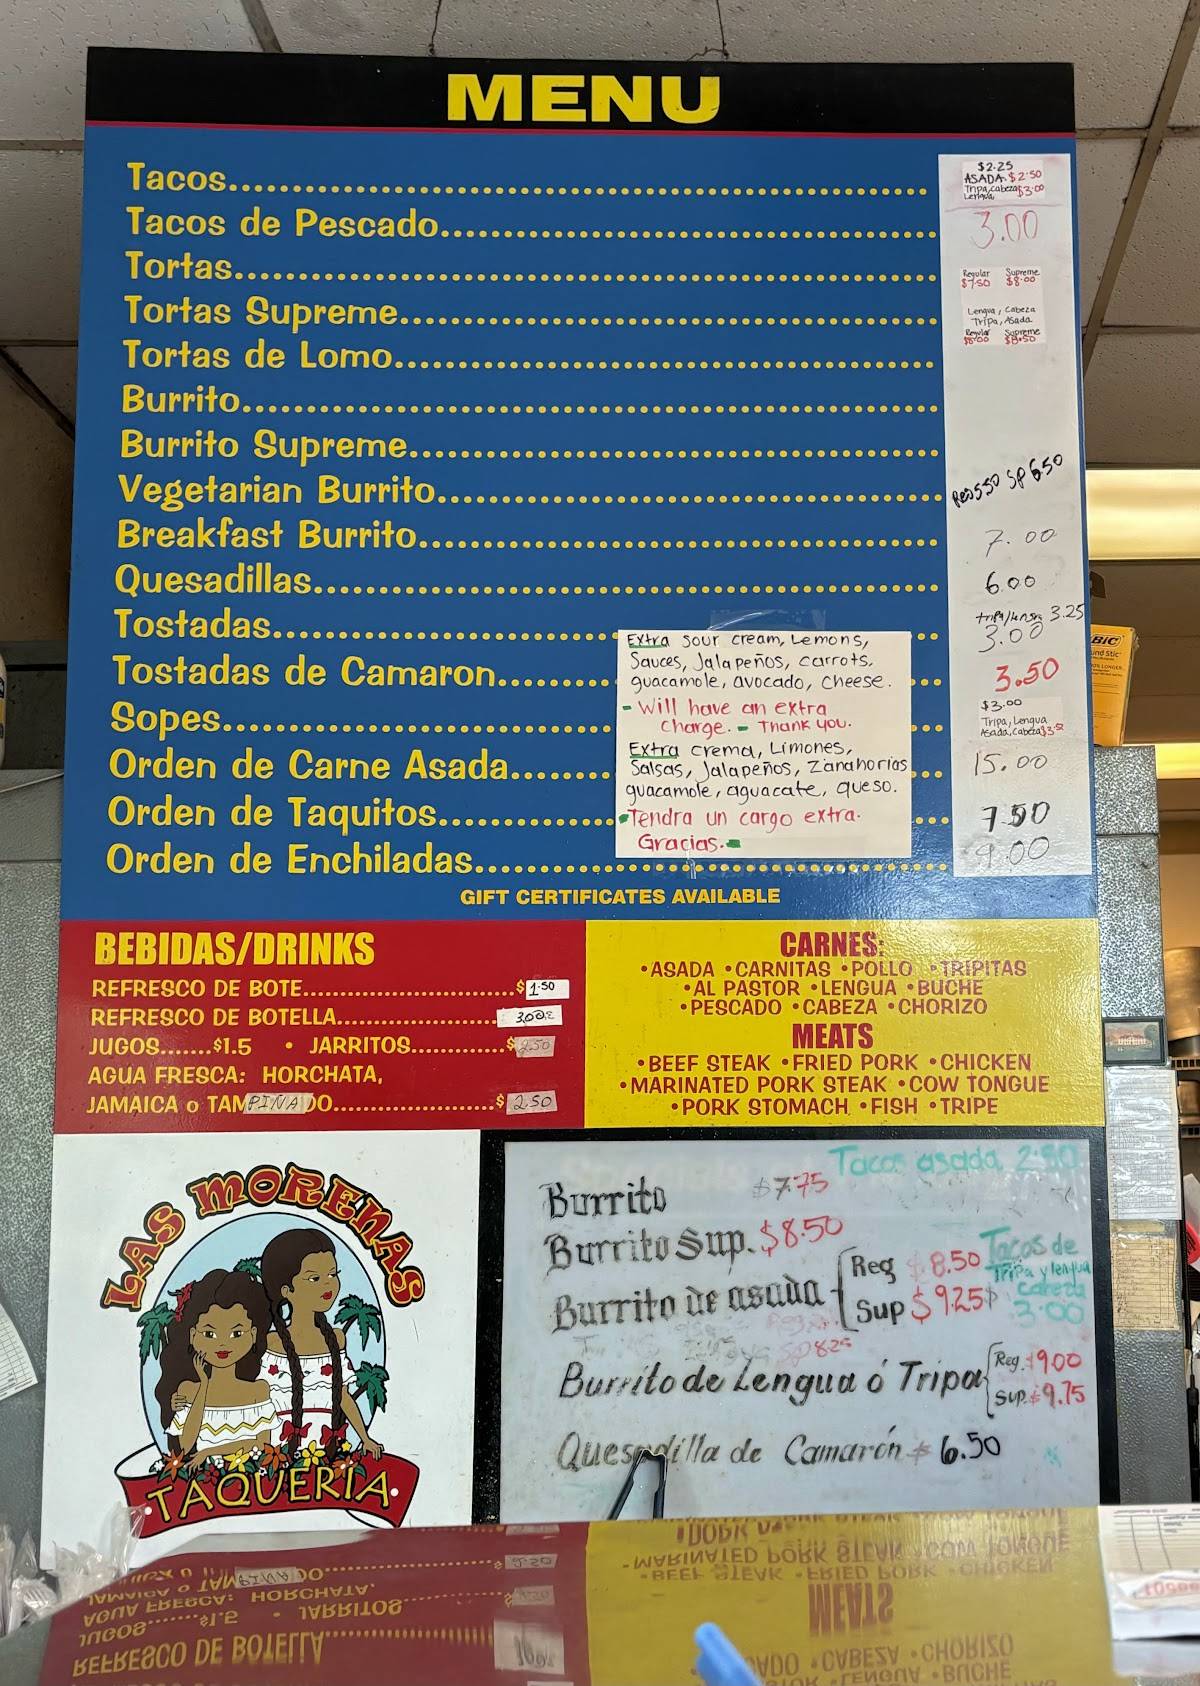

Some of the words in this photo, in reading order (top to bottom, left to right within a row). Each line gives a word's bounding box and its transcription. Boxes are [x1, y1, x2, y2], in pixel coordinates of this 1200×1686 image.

[448, 74, 720, 123] MENU
[127, 162, 226, 191] Tacos
[978, 161, 1013, 171] $2.25
[1008, 170, 1042, 182] $2.50
[126, 207, 225, 235] Tacos
[241, 206, 280, 236] de
[296, 208, 438, 237] Pescado
[972, 209, 1039, 249] 3.00
[125, 251, 232, 279] Tortas
[124, 295, 231, 324] Tortas
[246, 295, 397, 333] Supreme
[123, 340, 230, 368] Tortas
[245, 338, 285, 368] de
[301, 341, 392, 368] Lomo
[123, 384, 239, 412] Burrito
[121, 429, 238, 458] Burrito
[254, 429, 406, 467] Supreme
[118, 474, 302, 512] Vegetarian
[319, 475, 434, 503] Burrito
[118, 517, 283, 548] Breakfast
[299, 520, 416, 548] Burrito
[116, 562, 311, 597] Quesadillas
[114, 607, 270, 638] Tostadas
[1050, 603, 1085, 622] 3.25
[628, 634, 669, 648] Extra
[732, 633, 785, 648] cream,
[791, 633, 869, 651] Lemons,
[979, 621, 1043, 653] 3.00
[1092, 636, 1119, 646] BIC
[113, 654, 269, 685] Tostadas
[285, 654, 326, 685] de
[341, 656, 494, 686] Camaron
[631, 673, 726, 693] guacamole,
[733, 673, 813, 691] avocado,
[995, 657, 1059, 692] 3.50
[638, 698, 677, 716] Will
[689, 698, 729, 716] have
[741, 702, 766, 716] an
[775, 700, 827, 716] extra
[981, 698, 1022, 711] $3.00
[111, 701, 220, 741] Sopes
[758, 719, 810, 733] Thank
[1014, 717, 1047, 728] Lengua
[110, 747, 216, 778] Orden
[232, 747, 273, 778] de
[289, 749, 390, 779] Carne
[404, 748, 507, 779] Asada
[629, 741, 679, 756] Extra
[691, 744, 762, 758] crema,
[631, 759, 692, 777] Salsas,
[808, 758, 908, 774] Zanahorias
[975, 753, 1048, 776] 15.00
[626, 783, 721, 805] guacamole,
[727, 781, 827, 805] aguacate,
[836, 779, 897, 799] queso.
[108, 794, 215, 826] Orden
[231, 794, 272, 826] de
[288, 797, 436, 836] Taquitos
[628, 808, 692, 828] Tendra
[707, 812, 727, 826] un
[739, 811, 792, 834] cargo
[638, 833, 725, 852] Gracias.
[107, 842, 214, 873] Orden
[230, 842, 271, 873] de
[288, 842, 472, 874] Enchiladas
[461, 890, 509, 904] GIFT
[516, 889, 665, 904] CERTIFICATES
[672, 889, 780, 903] AVAILABLE
[95, 932, 374, 965] BEBIDAS/DRINKS
[93, 980, 205, 997] REFRESCO
[214, 980, 241, 997] DE
[250, 980, 302, 997] BOTE
[724, 980, 800, 996] PASTOR
[92, 1008, 204, 1026] REFRESCO
[214, 1008, 240, 1026] DE
[249, 1008, 336, 1025] BOTELLA
[89, 1038, 159, 1055] JUGOS
[310, 1036, 410, 1054] JARRITOS
[793, 1023, 873, 1049] MEATS
[88, 1067, 146, 1084] AGUA
[156, 1066, 245, 1084] FRESCA:
[263, 1065, 382, 1084] HORCHATA,
[707, 1055, 770, 1072] STEAK
[861, 1054, 918, 1070] PORK
[758, 1076, 814, 1093] PORK
[824, 1076, 886, 1093] STEAK
[967, 1073, 1049, 1092] TONGUE
[87, 1096, 178, 1113] JAMAICA
[749, 1098, 847, 1115] STOMACH
[540, 1176, 667, 1221] Burrito
[100, 1202, 187, 1312] LAS
[186, 1162, 425, 1308] MORENAS
[543, 1228, 669, 1277] Burrito
[761, 1215, 843, 1257] $8.50
[852, 1255, 896, 1283] Reg
[550, 1287, 676, 1334] Burrito
[686, 1285, 719, 1317] de
[728, 1273, 825, 1312] asada
[857, 1299, 904, 1324] Sup
[559, 1361, 676, 1399] Burrito
[683, 1363, 725, 1394] de
[733, 1357, 857, 1406] Lengua
[900, 1360, 982, 1397] Tripa
[730, 1439, 762, 1466] de
[785, 1425, 901, 1466] Camarón
[147, 1466, 392, 1523] TAQUERIA
